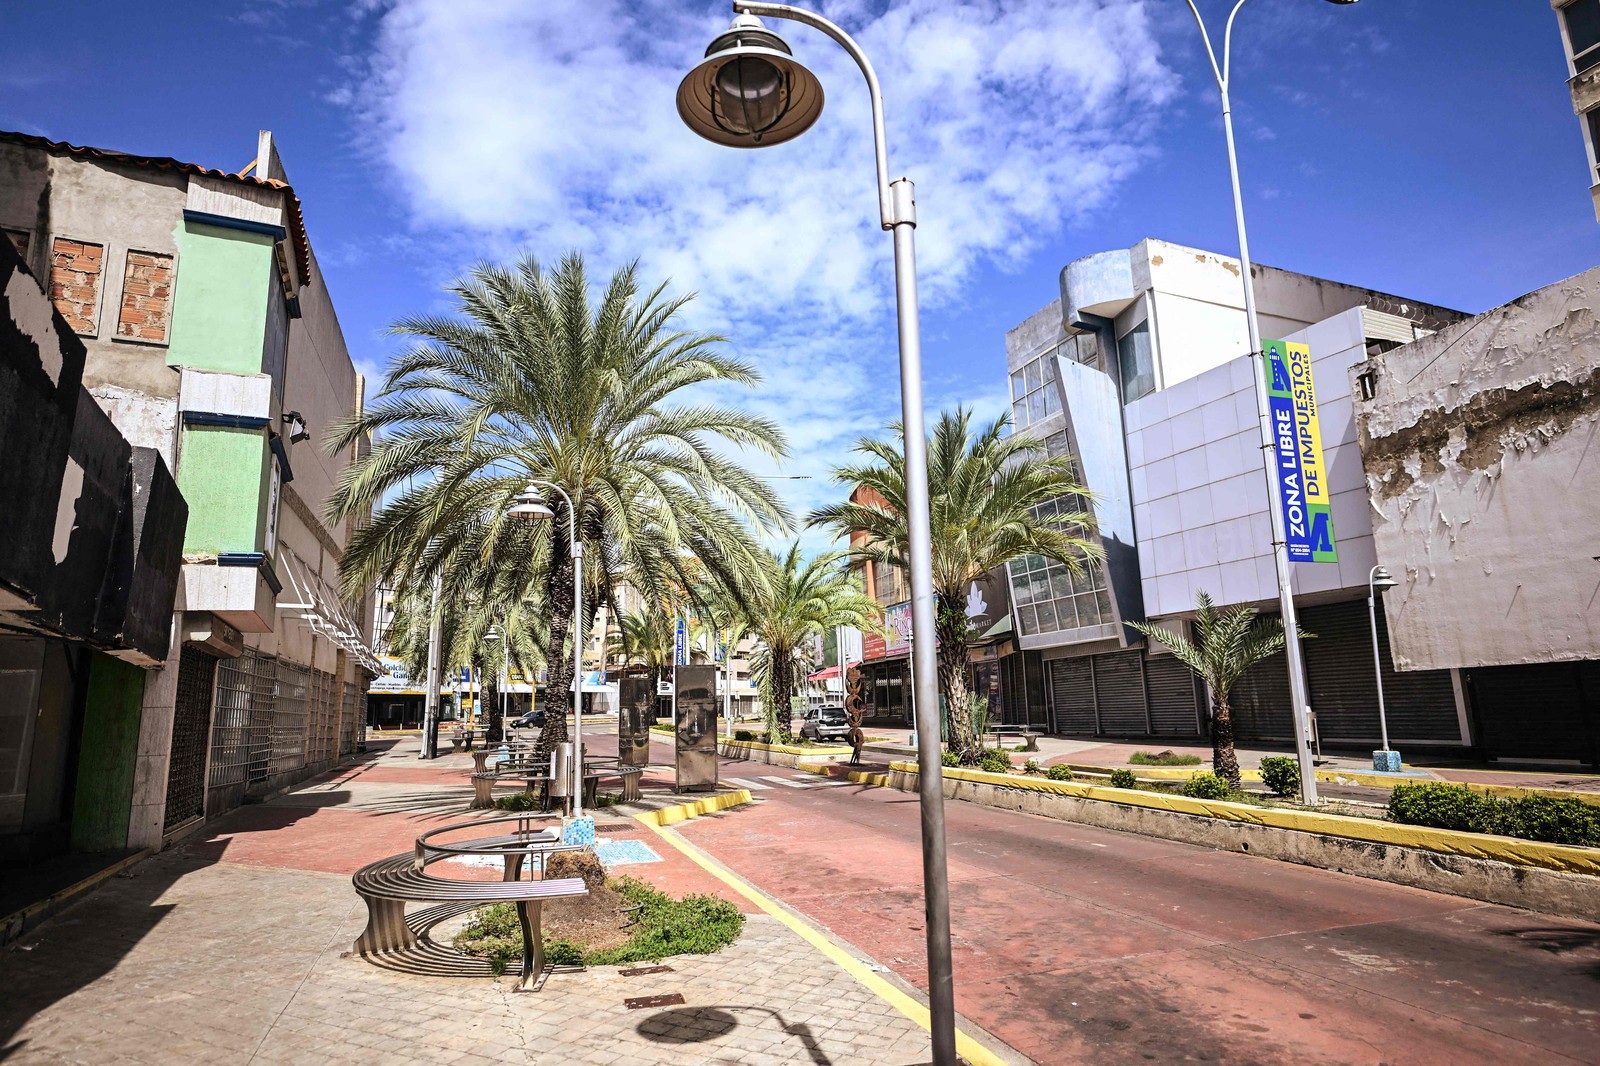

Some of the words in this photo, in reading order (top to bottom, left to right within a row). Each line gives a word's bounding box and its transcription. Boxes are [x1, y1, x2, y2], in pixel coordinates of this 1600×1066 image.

[1290, 351, 1315, 464] IMPUESTOS
[1303, 354, 1316, 416] MUNICIPALES
[1276, 409, 1296, 468] LIBRE
[1285, 473, 1305, 538] ZONA
[1305, 470, 1320, 496] DE
